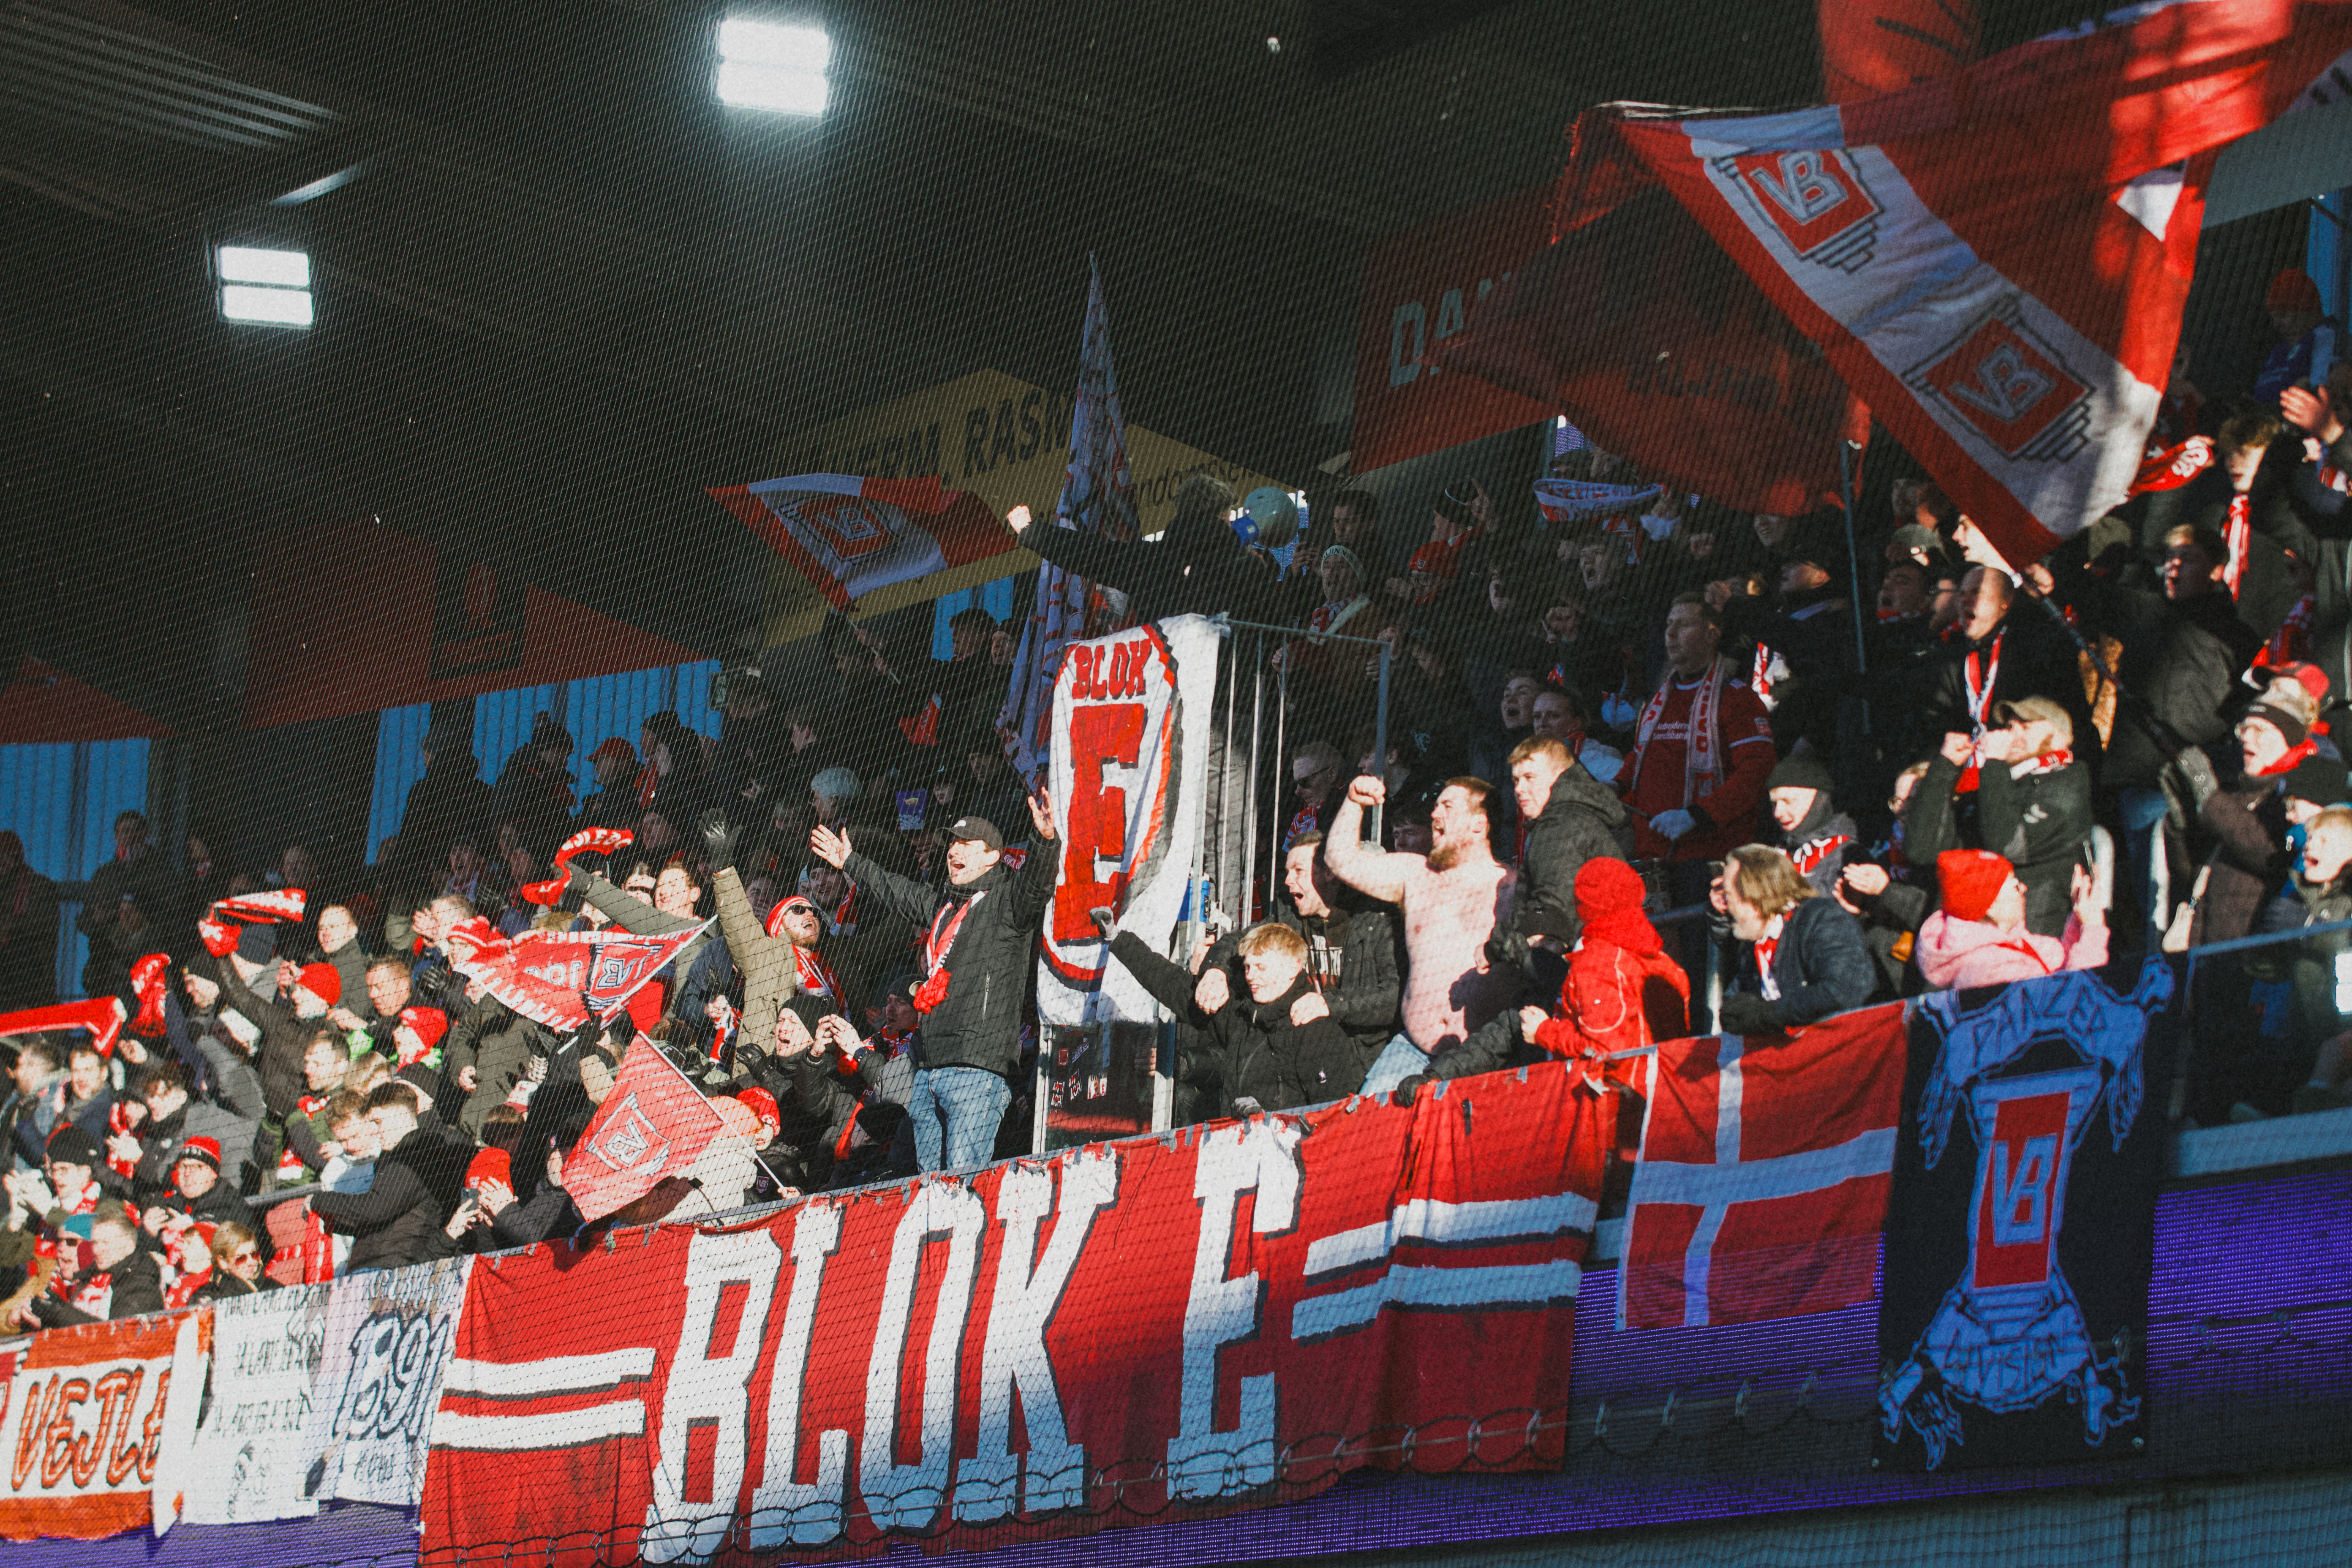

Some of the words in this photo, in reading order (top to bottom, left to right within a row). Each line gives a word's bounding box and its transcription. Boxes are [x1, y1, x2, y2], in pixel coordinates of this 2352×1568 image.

[1071, 638, 1152, 700] BLOK
[1992, 1134, 2058, 1247] VB
[641, 1145, 1119, 1565] BLOK
